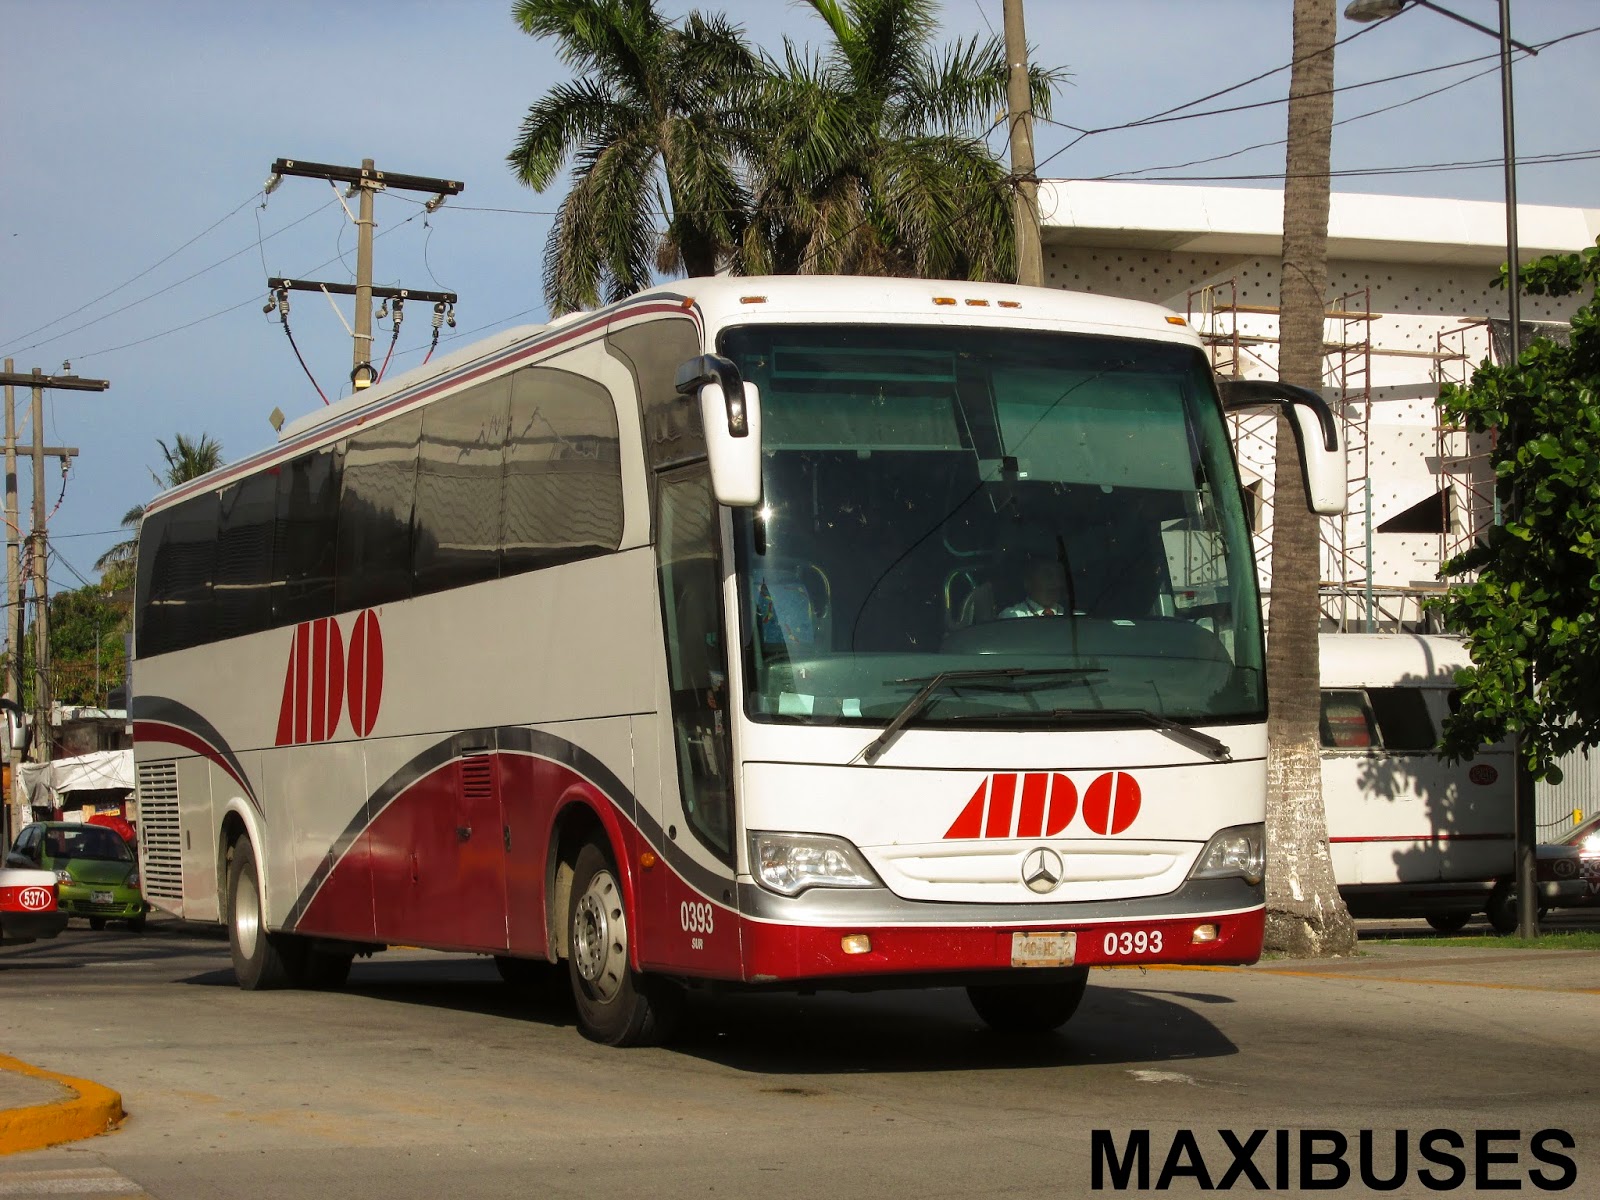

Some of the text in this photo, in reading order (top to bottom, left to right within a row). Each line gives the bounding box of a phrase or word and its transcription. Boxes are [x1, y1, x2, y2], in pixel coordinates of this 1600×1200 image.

[275, 609, 384, 747] ADO
[942, 771, 1142, 839] ADO
[24, 891, 45, 906] 5371
[681, 901, 714, 934] 0393
[691, 938, 703, 950] SUR
[1103, 930, 1163, 956] 0393
